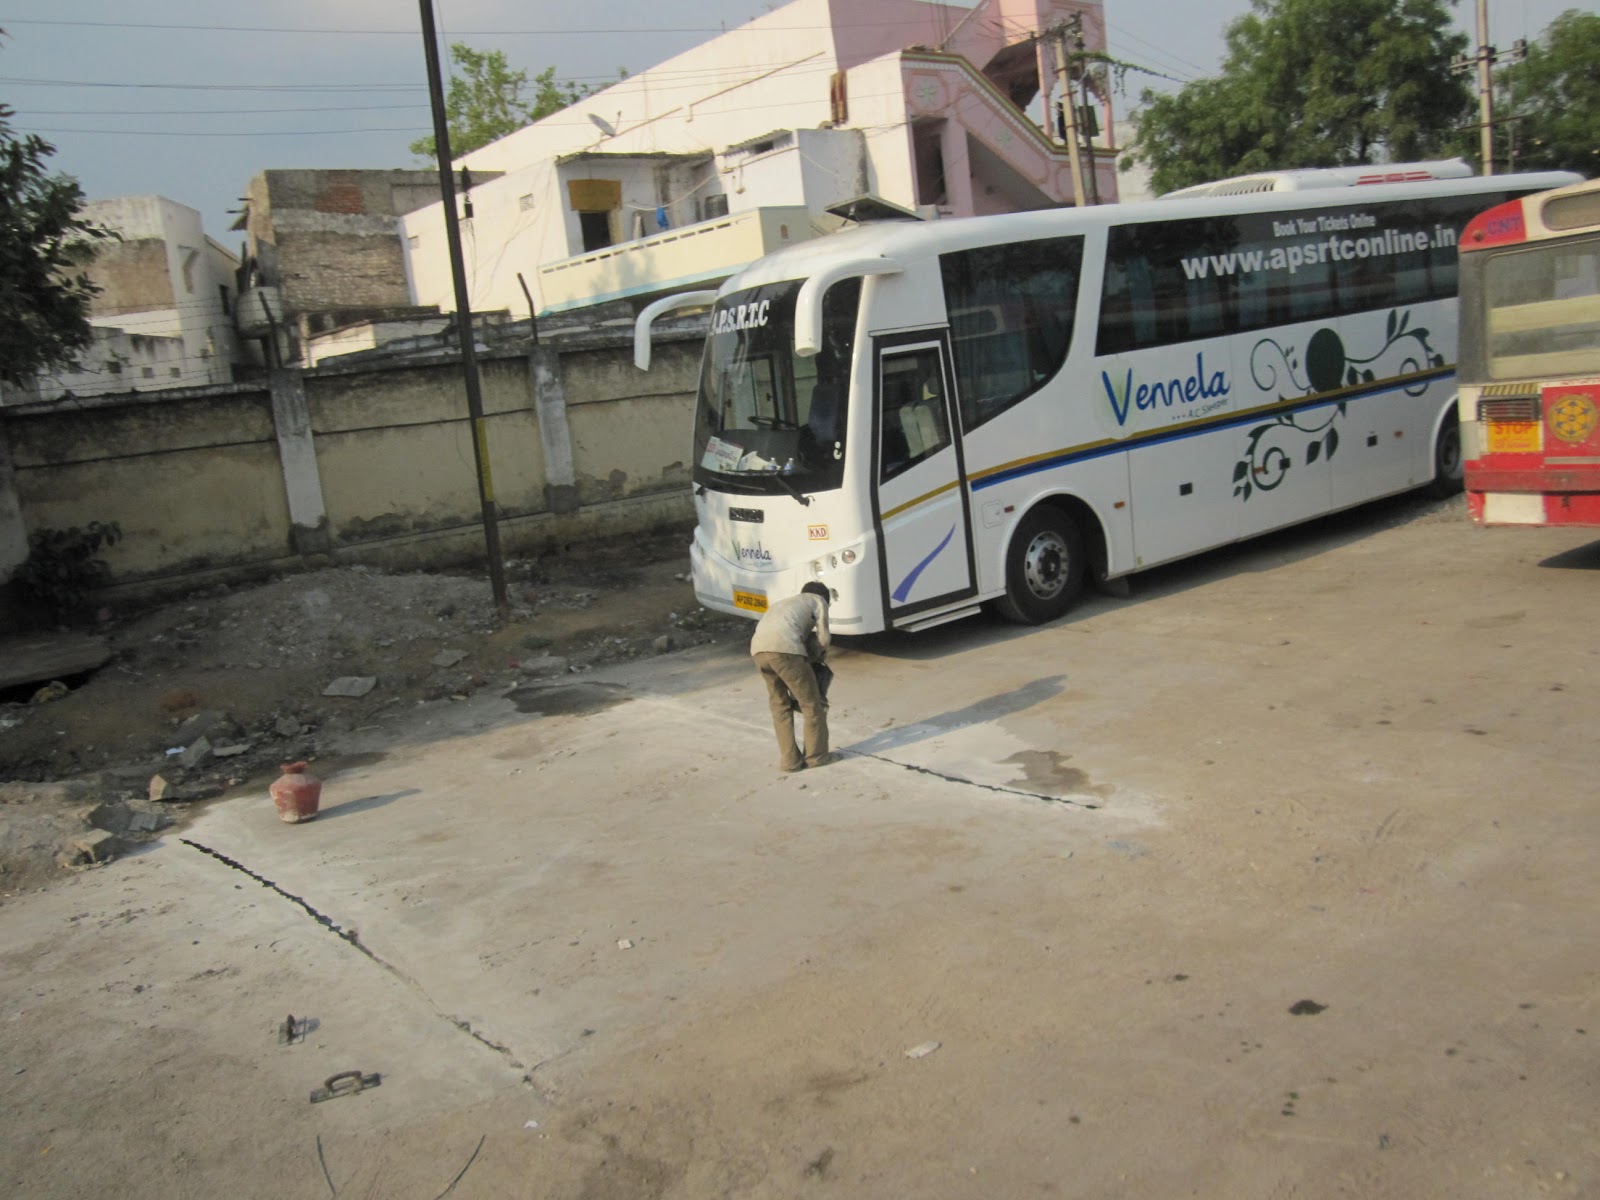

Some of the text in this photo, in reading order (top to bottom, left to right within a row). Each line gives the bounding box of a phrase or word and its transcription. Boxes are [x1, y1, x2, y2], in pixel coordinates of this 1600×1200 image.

[1273, 213, 1376, 237] Book Your Tickets Online
[1180, 224, 1456, 281] www.apsrtconline.in
[1102, 351, 1231, 426] Vennela
[809, 527, 827, 538] KKD
[731, 539, 772, 561] Vennela
